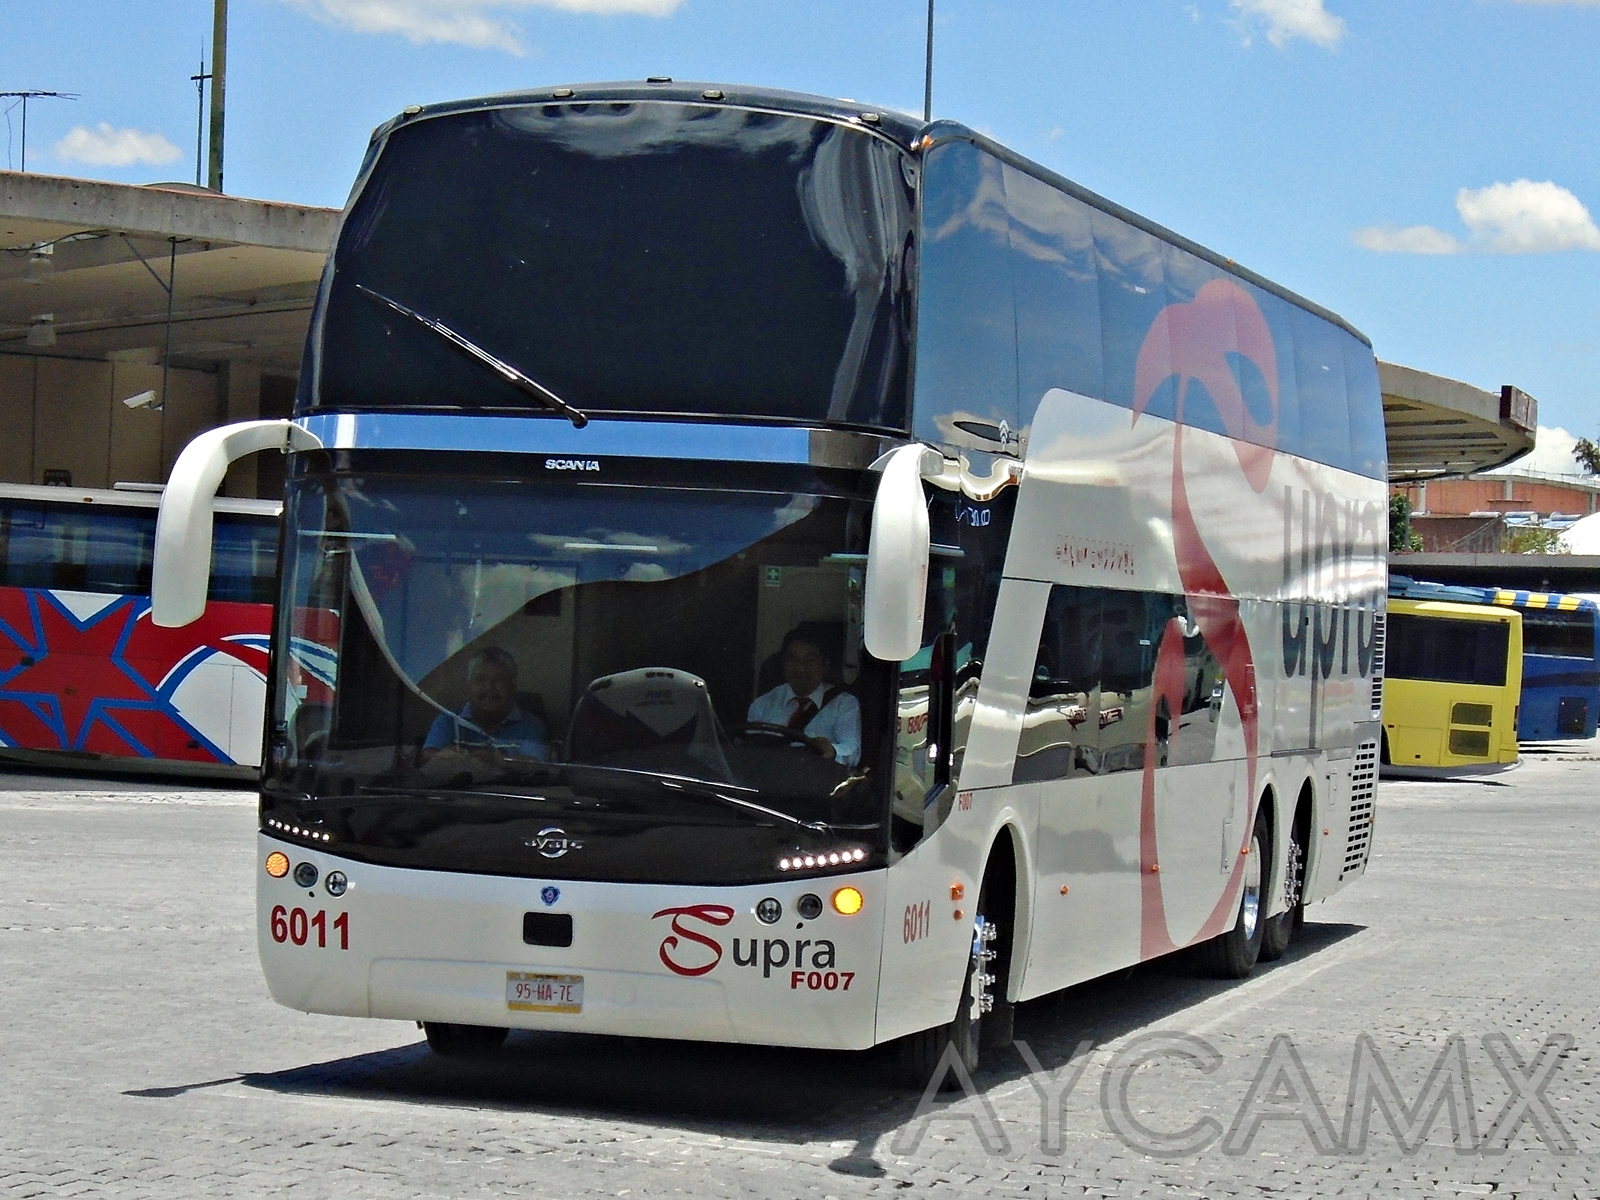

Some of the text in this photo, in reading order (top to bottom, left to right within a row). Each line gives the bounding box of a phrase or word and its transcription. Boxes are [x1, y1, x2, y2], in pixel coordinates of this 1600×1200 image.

[545, 458, 600, 471] SCANIA
[271, 904, 348, 950] 6011
[652, 904, 835, 978] Supra
[903, 899, 931, 944] 6011
[790, 970, 855, 991] F007
